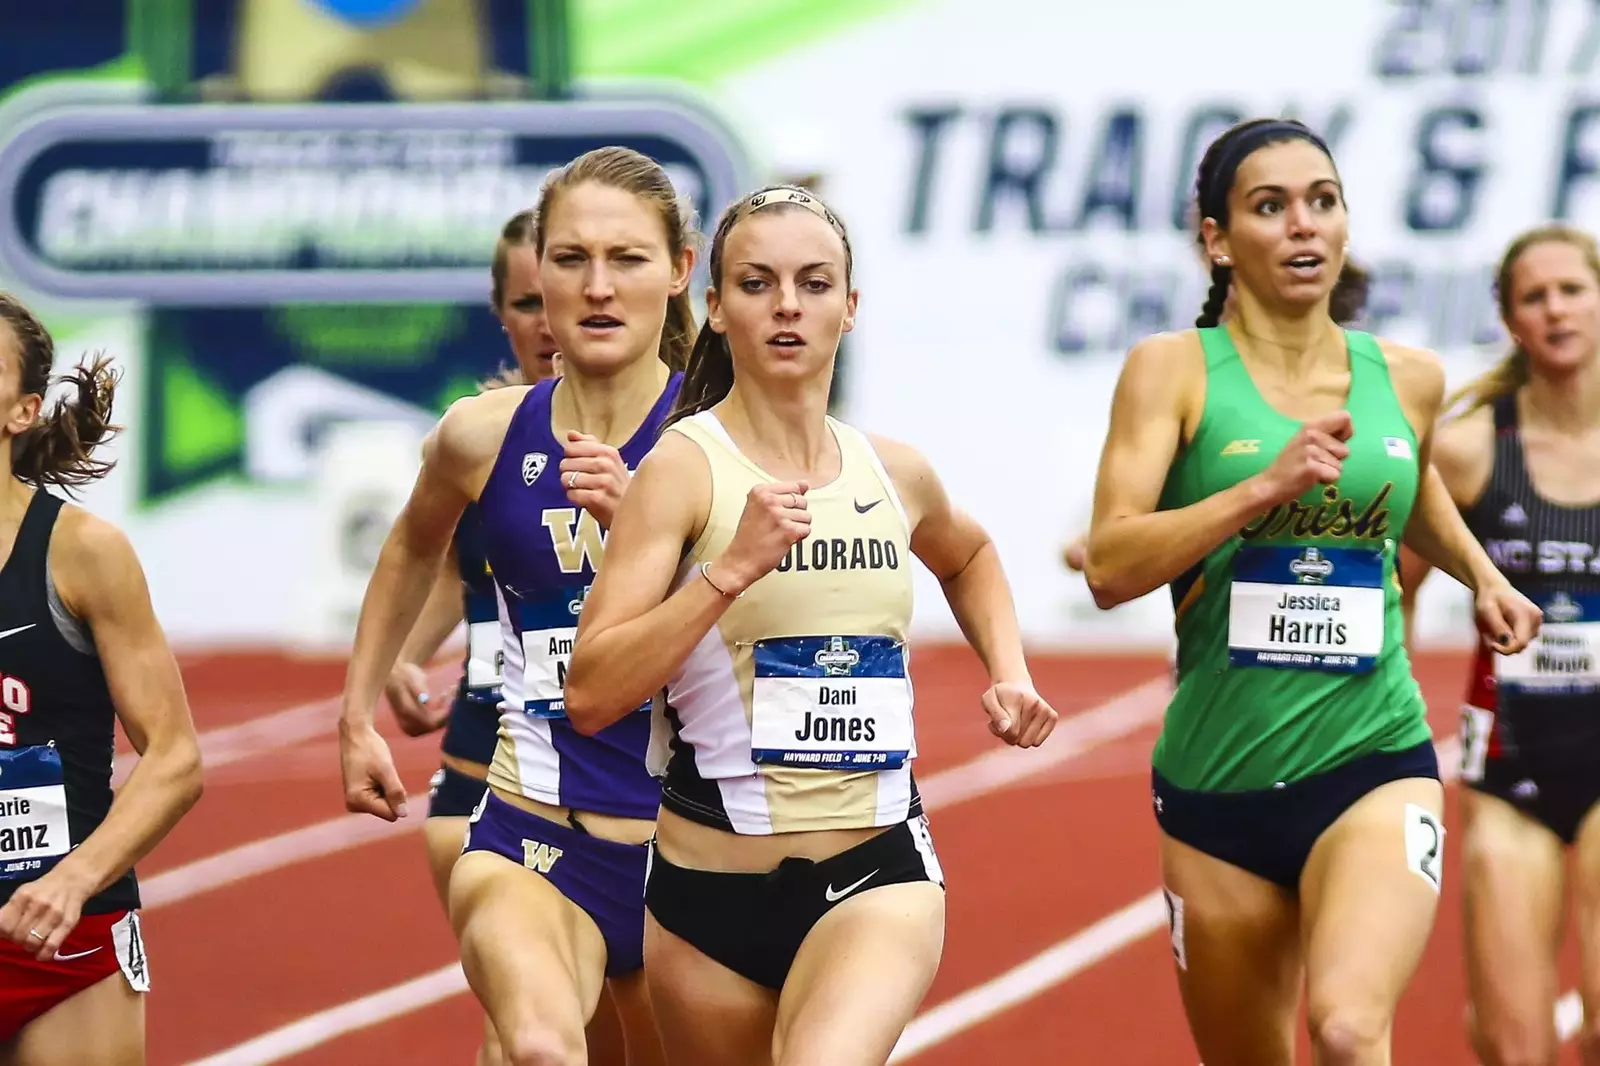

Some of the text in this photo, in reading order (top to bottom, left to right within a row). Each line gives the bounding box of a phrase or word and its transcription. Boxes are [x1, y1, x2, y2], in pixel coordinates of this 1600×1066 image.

[898, 106, 1354, 232] TRAC
[1405, 107, 1484, 231] &
[541, 507, 609, 573] W
[776, 538, 898, 572] OLORADO
[1278, 592, 1340, 611] Jessica
[1268, 614, 1347, 645] Harris
[819, 686, 856, 705] Dani
[795, 711, 875, 741] Jones
[783, 752, 887, 763] HAYWARD FIELD JUNE 7-10
[521, 838, 563, 873] W
[1420, 815, 1437, 884] 2
[4, 861, 24, 872] JUNE
